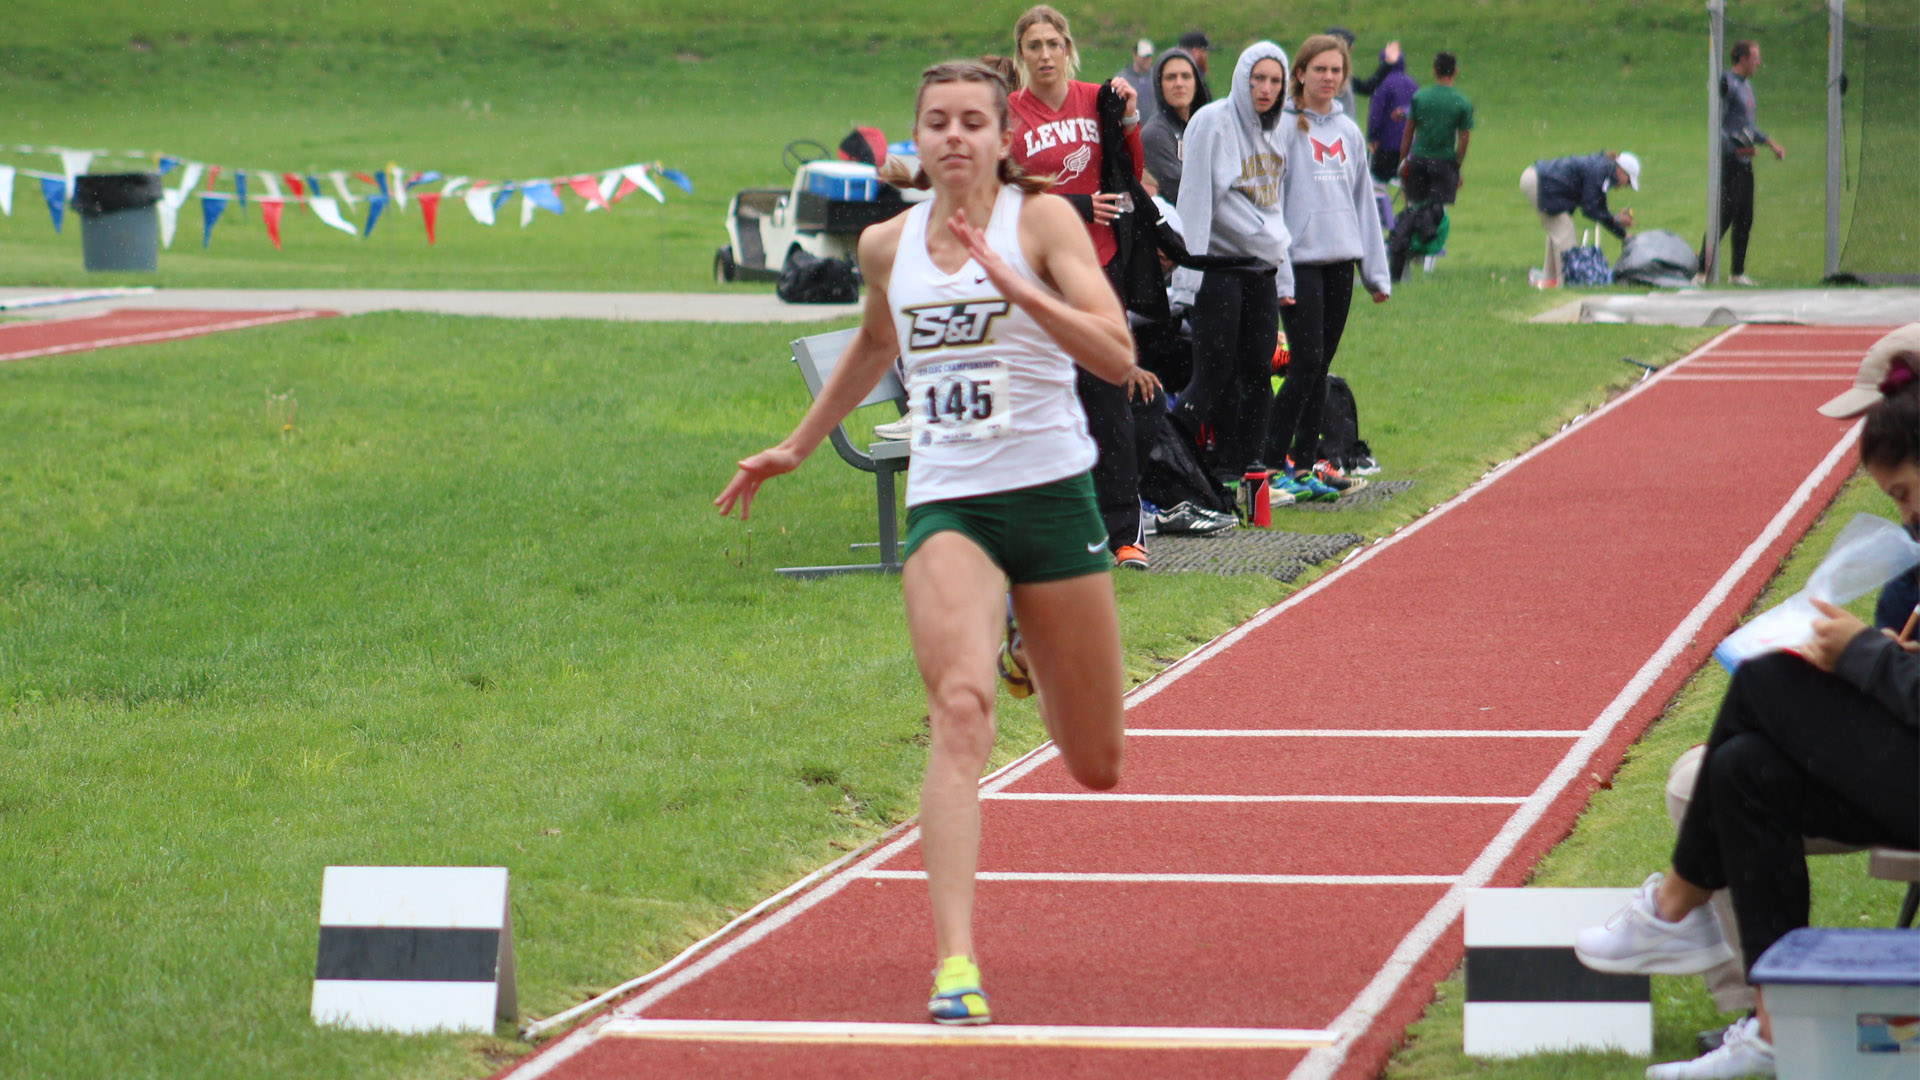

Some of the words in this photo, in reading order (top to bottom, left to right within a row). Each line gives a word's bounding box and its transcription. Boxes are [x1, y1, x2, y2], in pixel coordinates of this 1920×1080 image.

[1024, 117, 1100, 158] LEWIS
[1308, 134, 1347, 167] M
[902, 299, 1011, 352] S&T
[926, 379, 993, 424] 145
